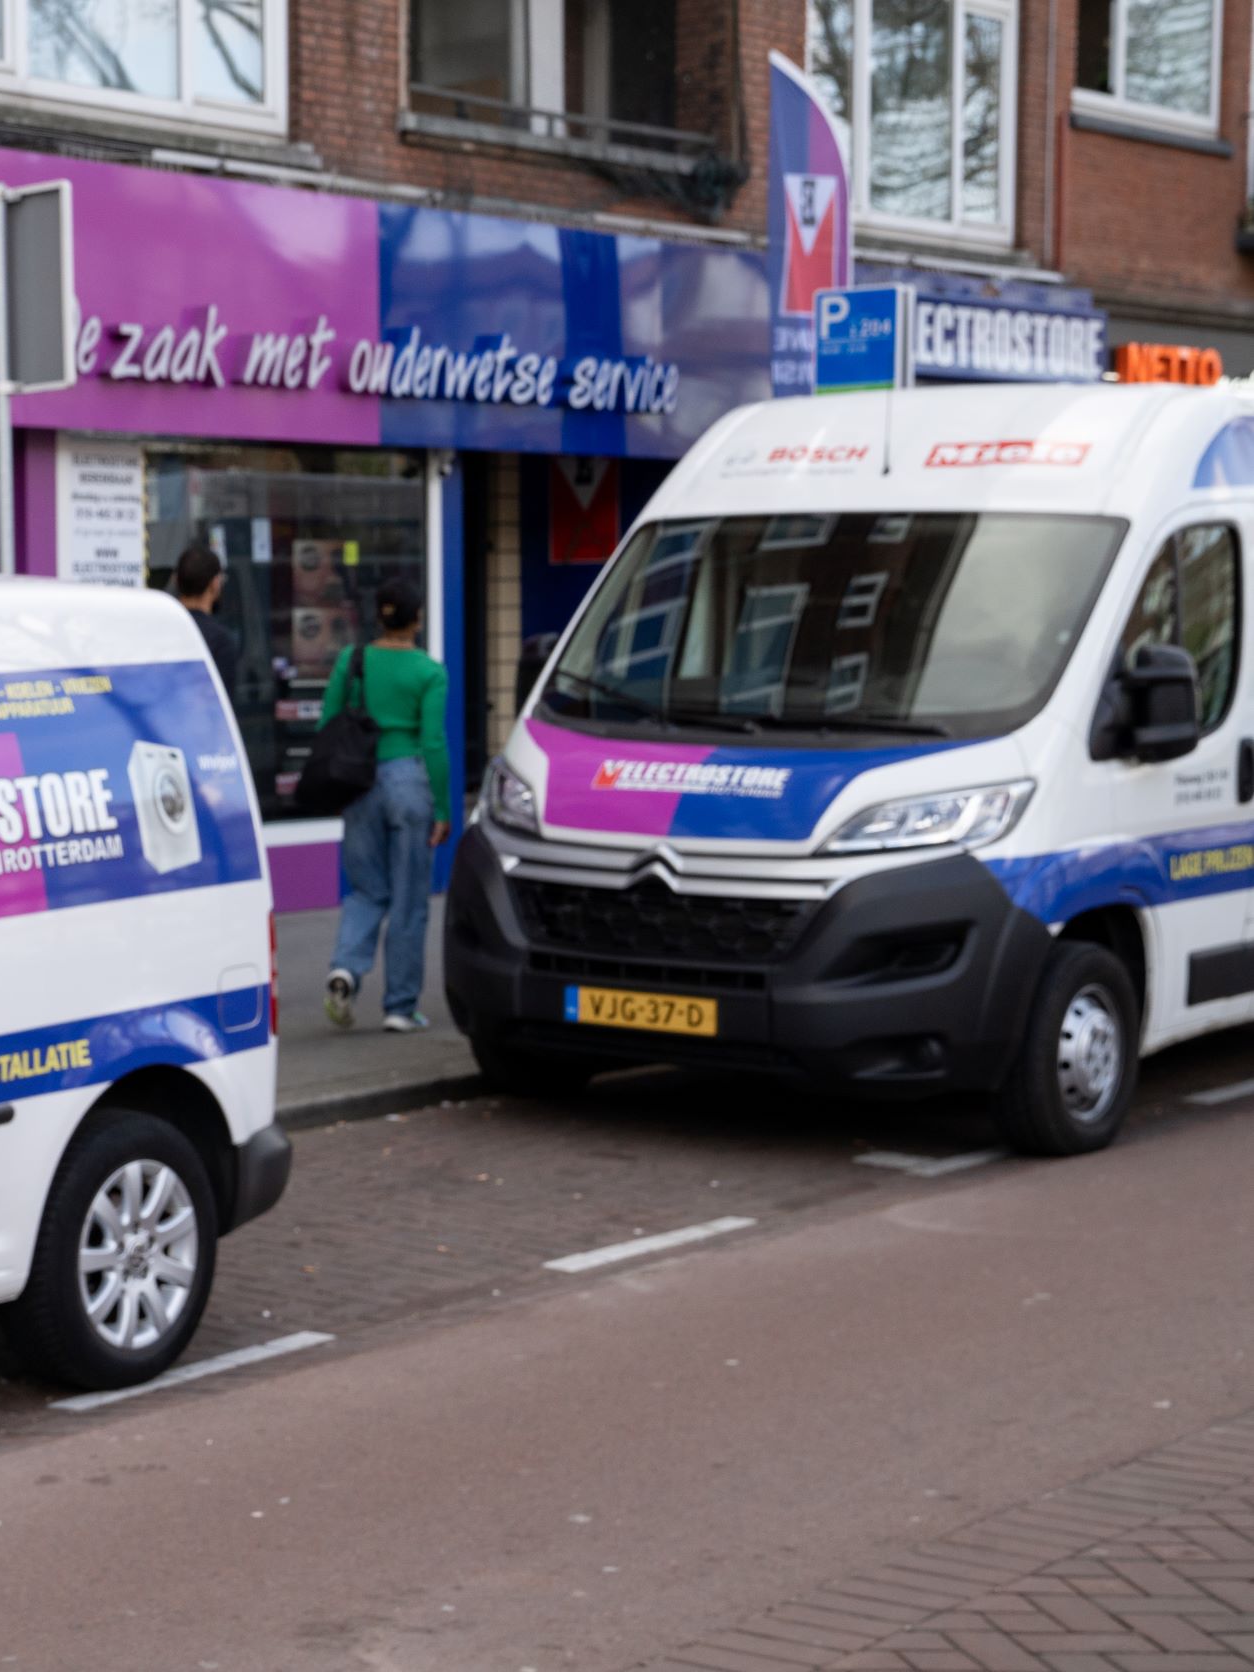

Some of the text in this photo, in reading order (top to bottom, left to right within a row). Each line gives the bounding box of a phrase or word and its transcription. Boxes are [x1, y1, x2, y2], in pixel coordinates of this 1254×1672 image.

[820, 295, 850, 340] P
[110, 303, 227, 388] zaak
[244, 315, 336, 390] met
[348, 325, 557, 406] ouderwetse
[567, 355, 680, 415] service
[915, 302, 1104, 377] ECTROSTORE
[1118, 341, 1223, 386] NETTO
[767, 446, 869, 463] BOSCH
[619, 761, 793, 789] ELECTROSTORE
[2, 834, 124, 873] ROTTERDAM
[589, 994, 705, 1028] VJG-37-D
